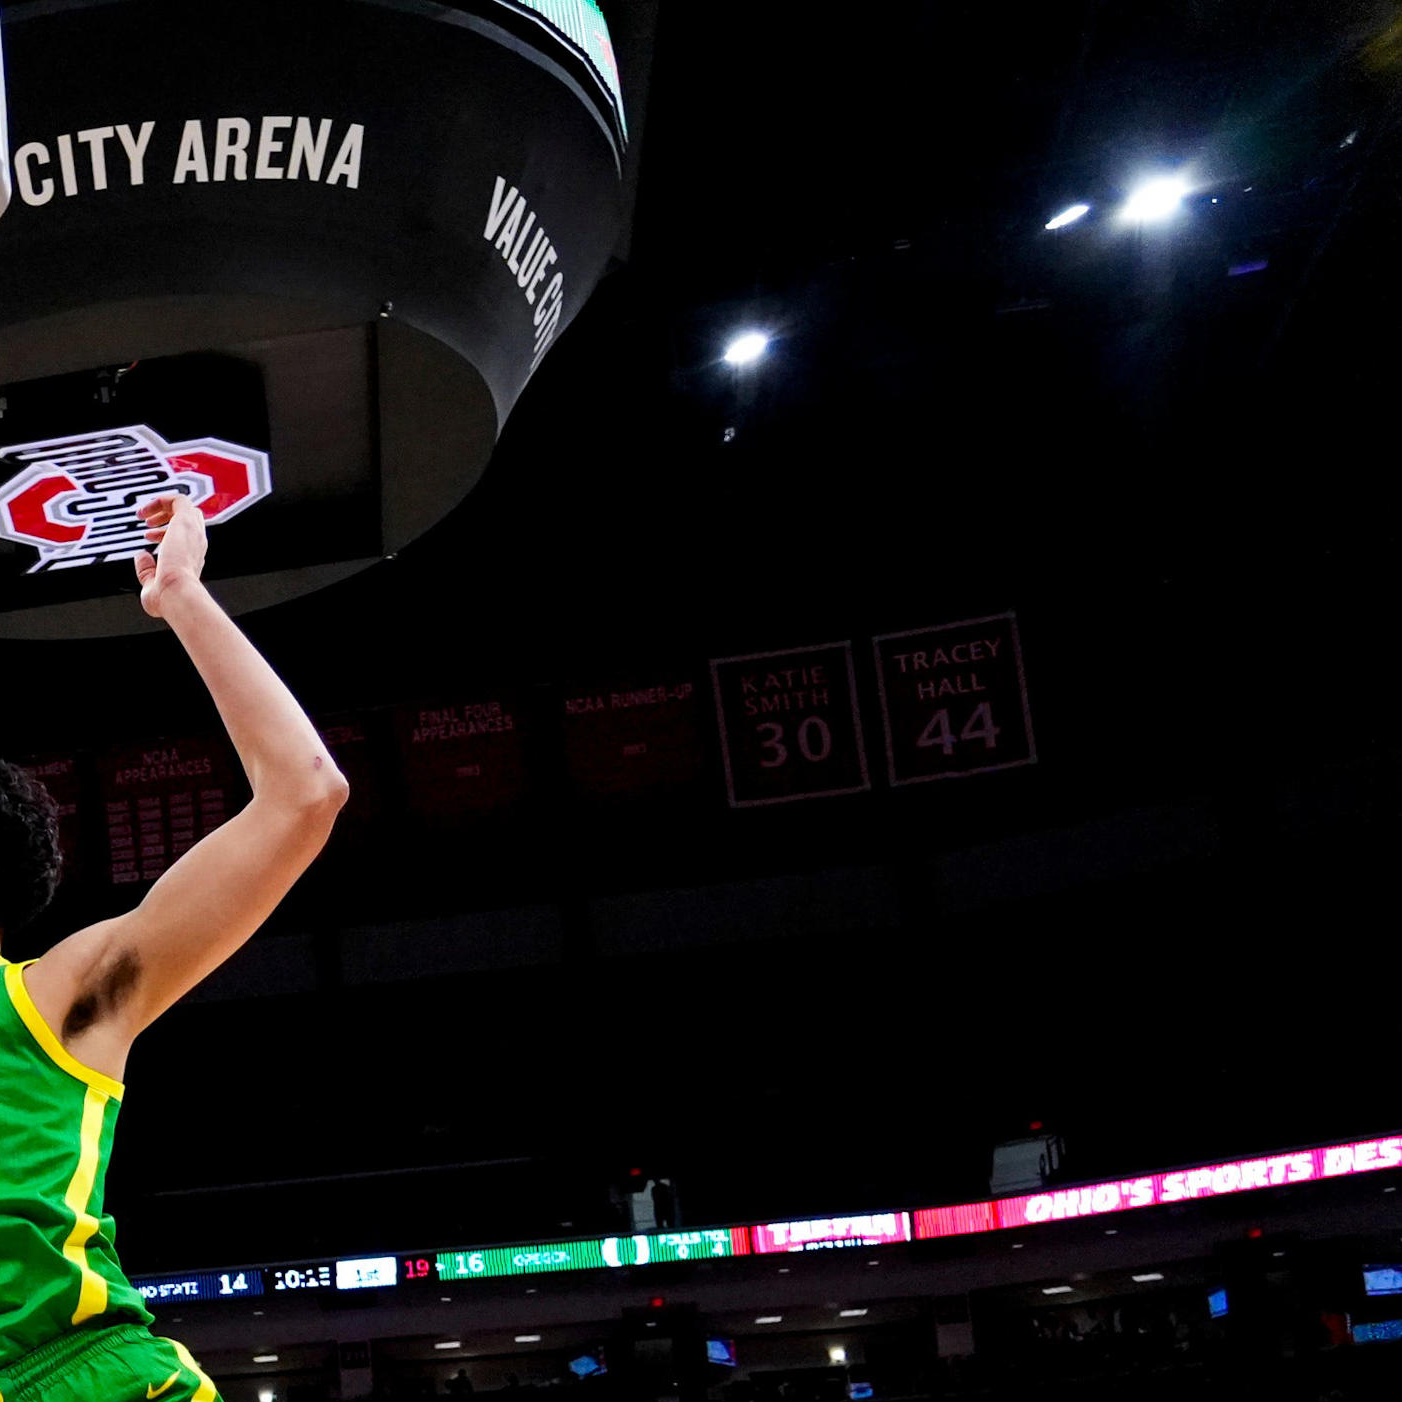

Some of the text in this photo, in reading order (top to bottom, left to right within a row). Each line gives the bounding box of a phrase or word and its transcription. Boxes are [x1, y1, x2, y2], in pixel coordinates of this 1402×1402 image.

[14, 115, 365, 207] CITY ARENA
[483, 175, 558, 305] VALUE
[892, 635, 1004, 674] TRACEY
[740, 665, 830, 694] KATIE
[916, 671, 989, 701] HALL
[742, 688, 830, 717] SMITH
[755, 714, 834, 770] 30
[915, 700, 1002, 757] 44
[1024, 1175, 1154, 1224] OHIO'S
[1161, 1152, 1314, 1202] SPORTS
[404, 1258, 430, 1279] 19
[455, 1253, 484, 1275] 16
[218, 1272, 248, 1295] 14
